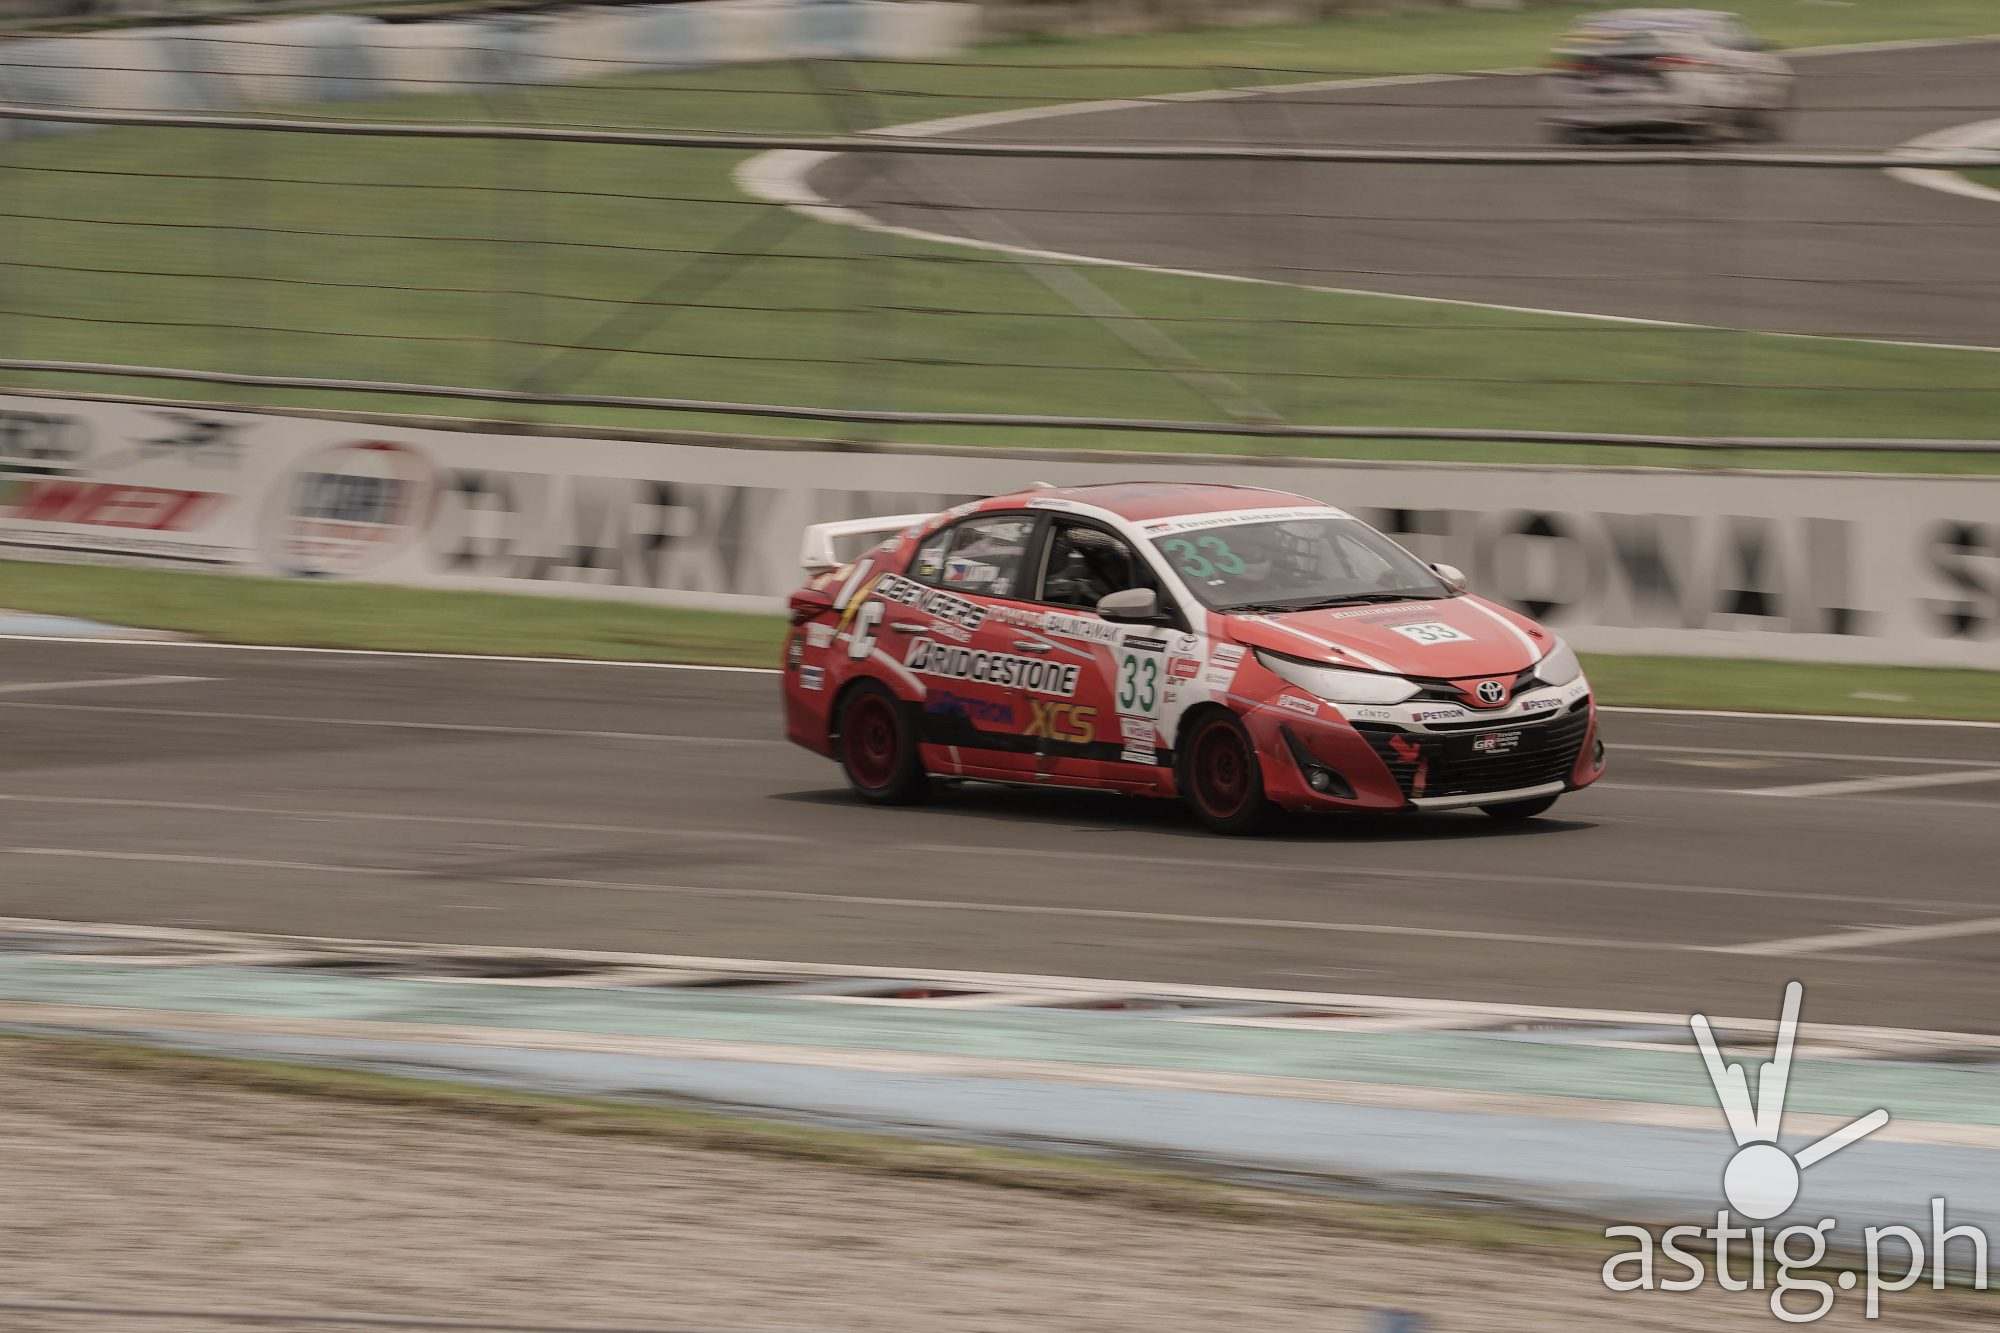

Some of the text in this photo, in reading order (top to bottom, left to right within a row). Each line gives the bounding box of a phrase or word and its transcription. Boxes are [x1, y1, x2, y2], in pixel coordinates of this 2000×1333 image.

[1163, 535, 1246, 578] 33
[1406, 625, 1459, 641] 33
[905, 640, 1077, 694] BRIDGESTONE
[1120, 654, 1157, 712] 33
[1023, 697, 1097, 743] XCS
[1422, 708, 1465, 720] PETRON
[1529, 698, 1562, 709] PETRON
